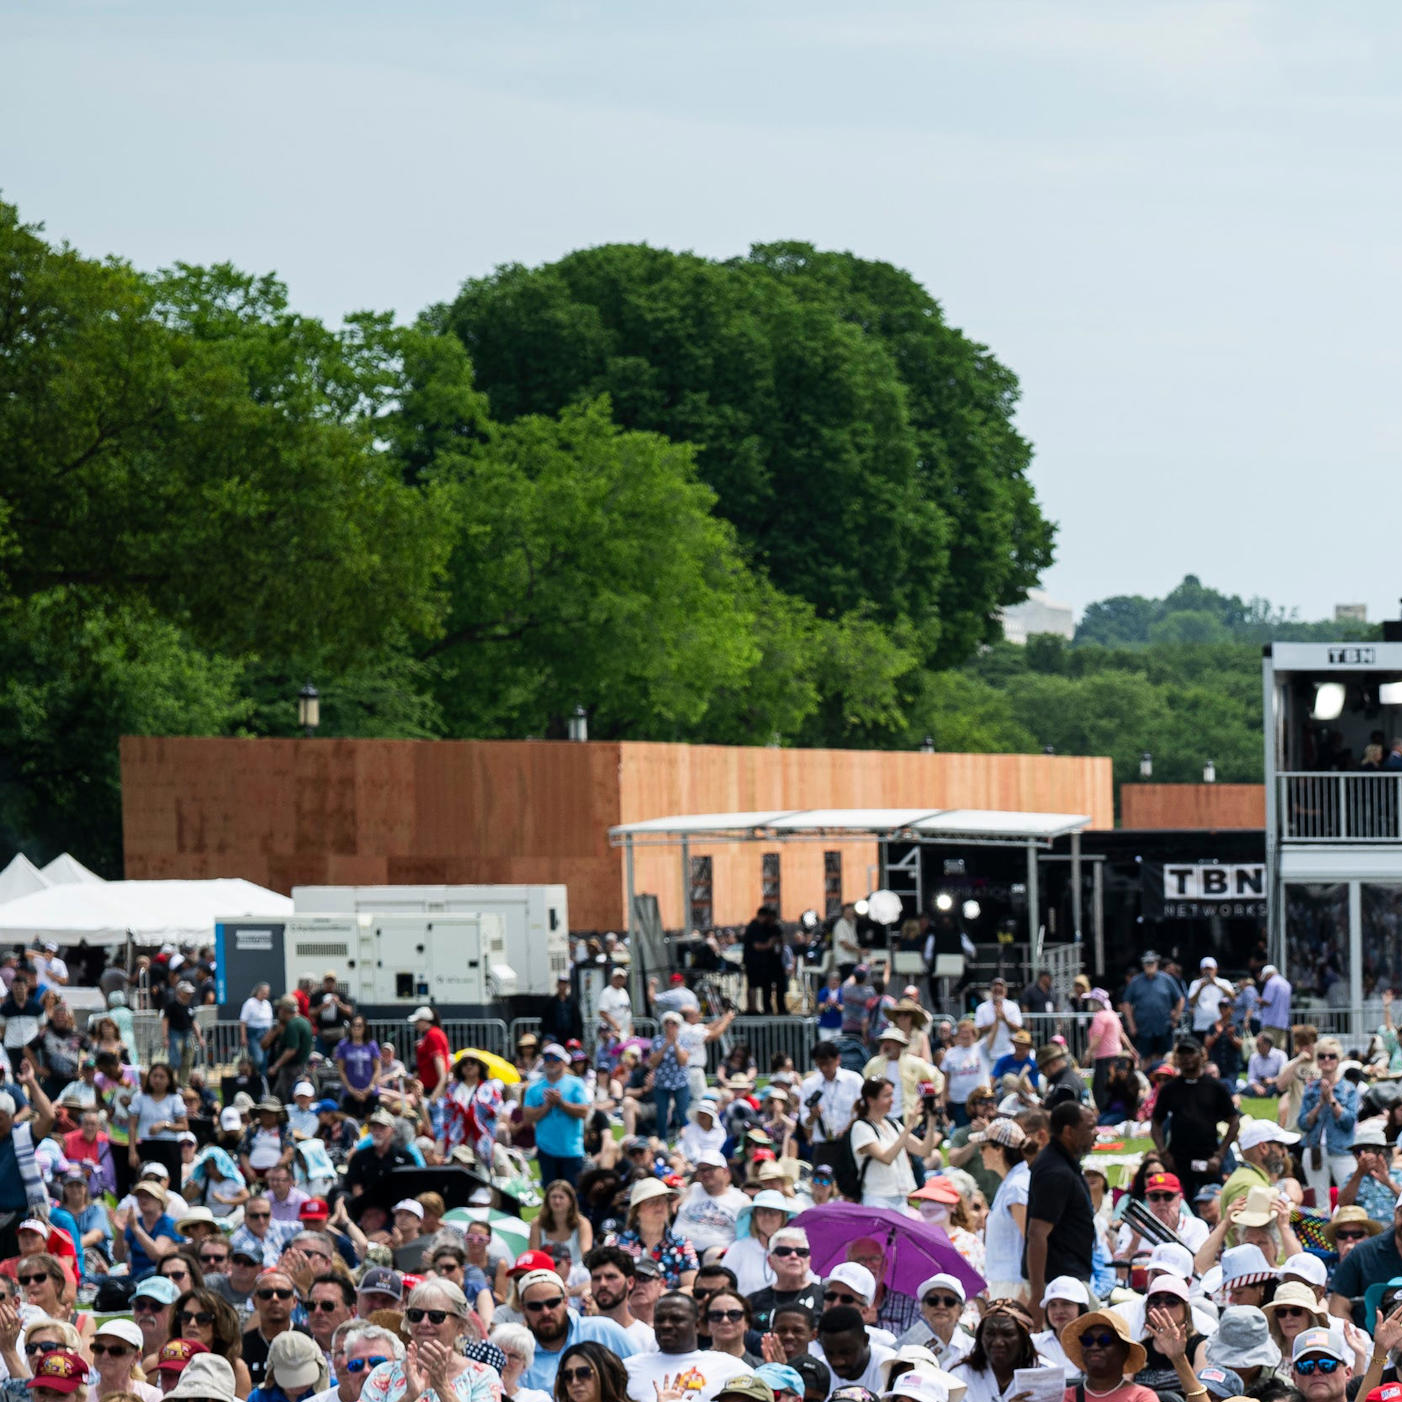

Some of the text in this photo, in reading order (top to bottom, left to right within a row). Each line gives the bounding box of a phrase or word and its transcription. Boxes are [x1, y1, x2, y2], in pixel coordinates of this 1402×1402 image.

[1328, 648, 1375, 664] TBN
[1167, 867, 1264, 895] TBN
[1164, 903, 1268, 917] NETWORKS
